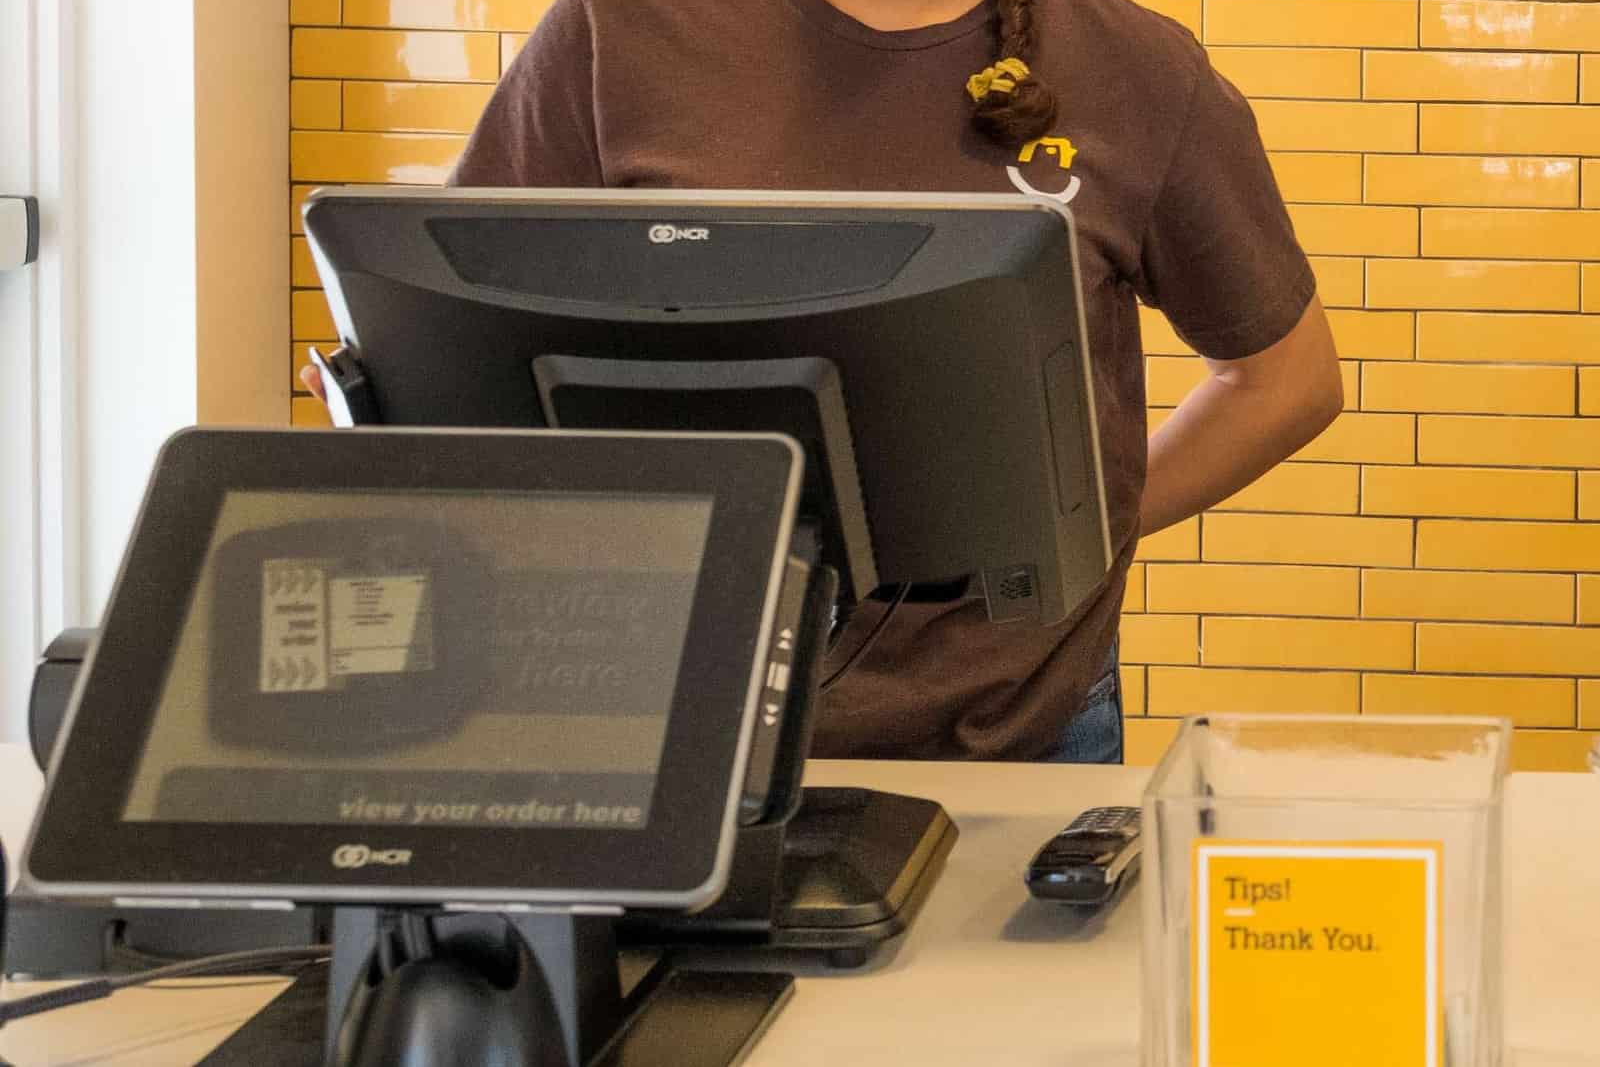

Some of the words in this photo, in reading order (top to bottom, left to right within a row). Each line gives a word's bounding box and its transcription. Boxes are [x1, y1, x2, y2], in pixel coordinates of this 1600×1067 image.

[339, 799, 407, 820] view
[413, 802, 480, 825] your
[485, 800, 566, 822] order
[573, 801, 641, 823] here
[1224, 876, 1291, 905] Tips!
[1224, 926, 1313, 950] Thank
[1322, 927, 1381, 952] You.
